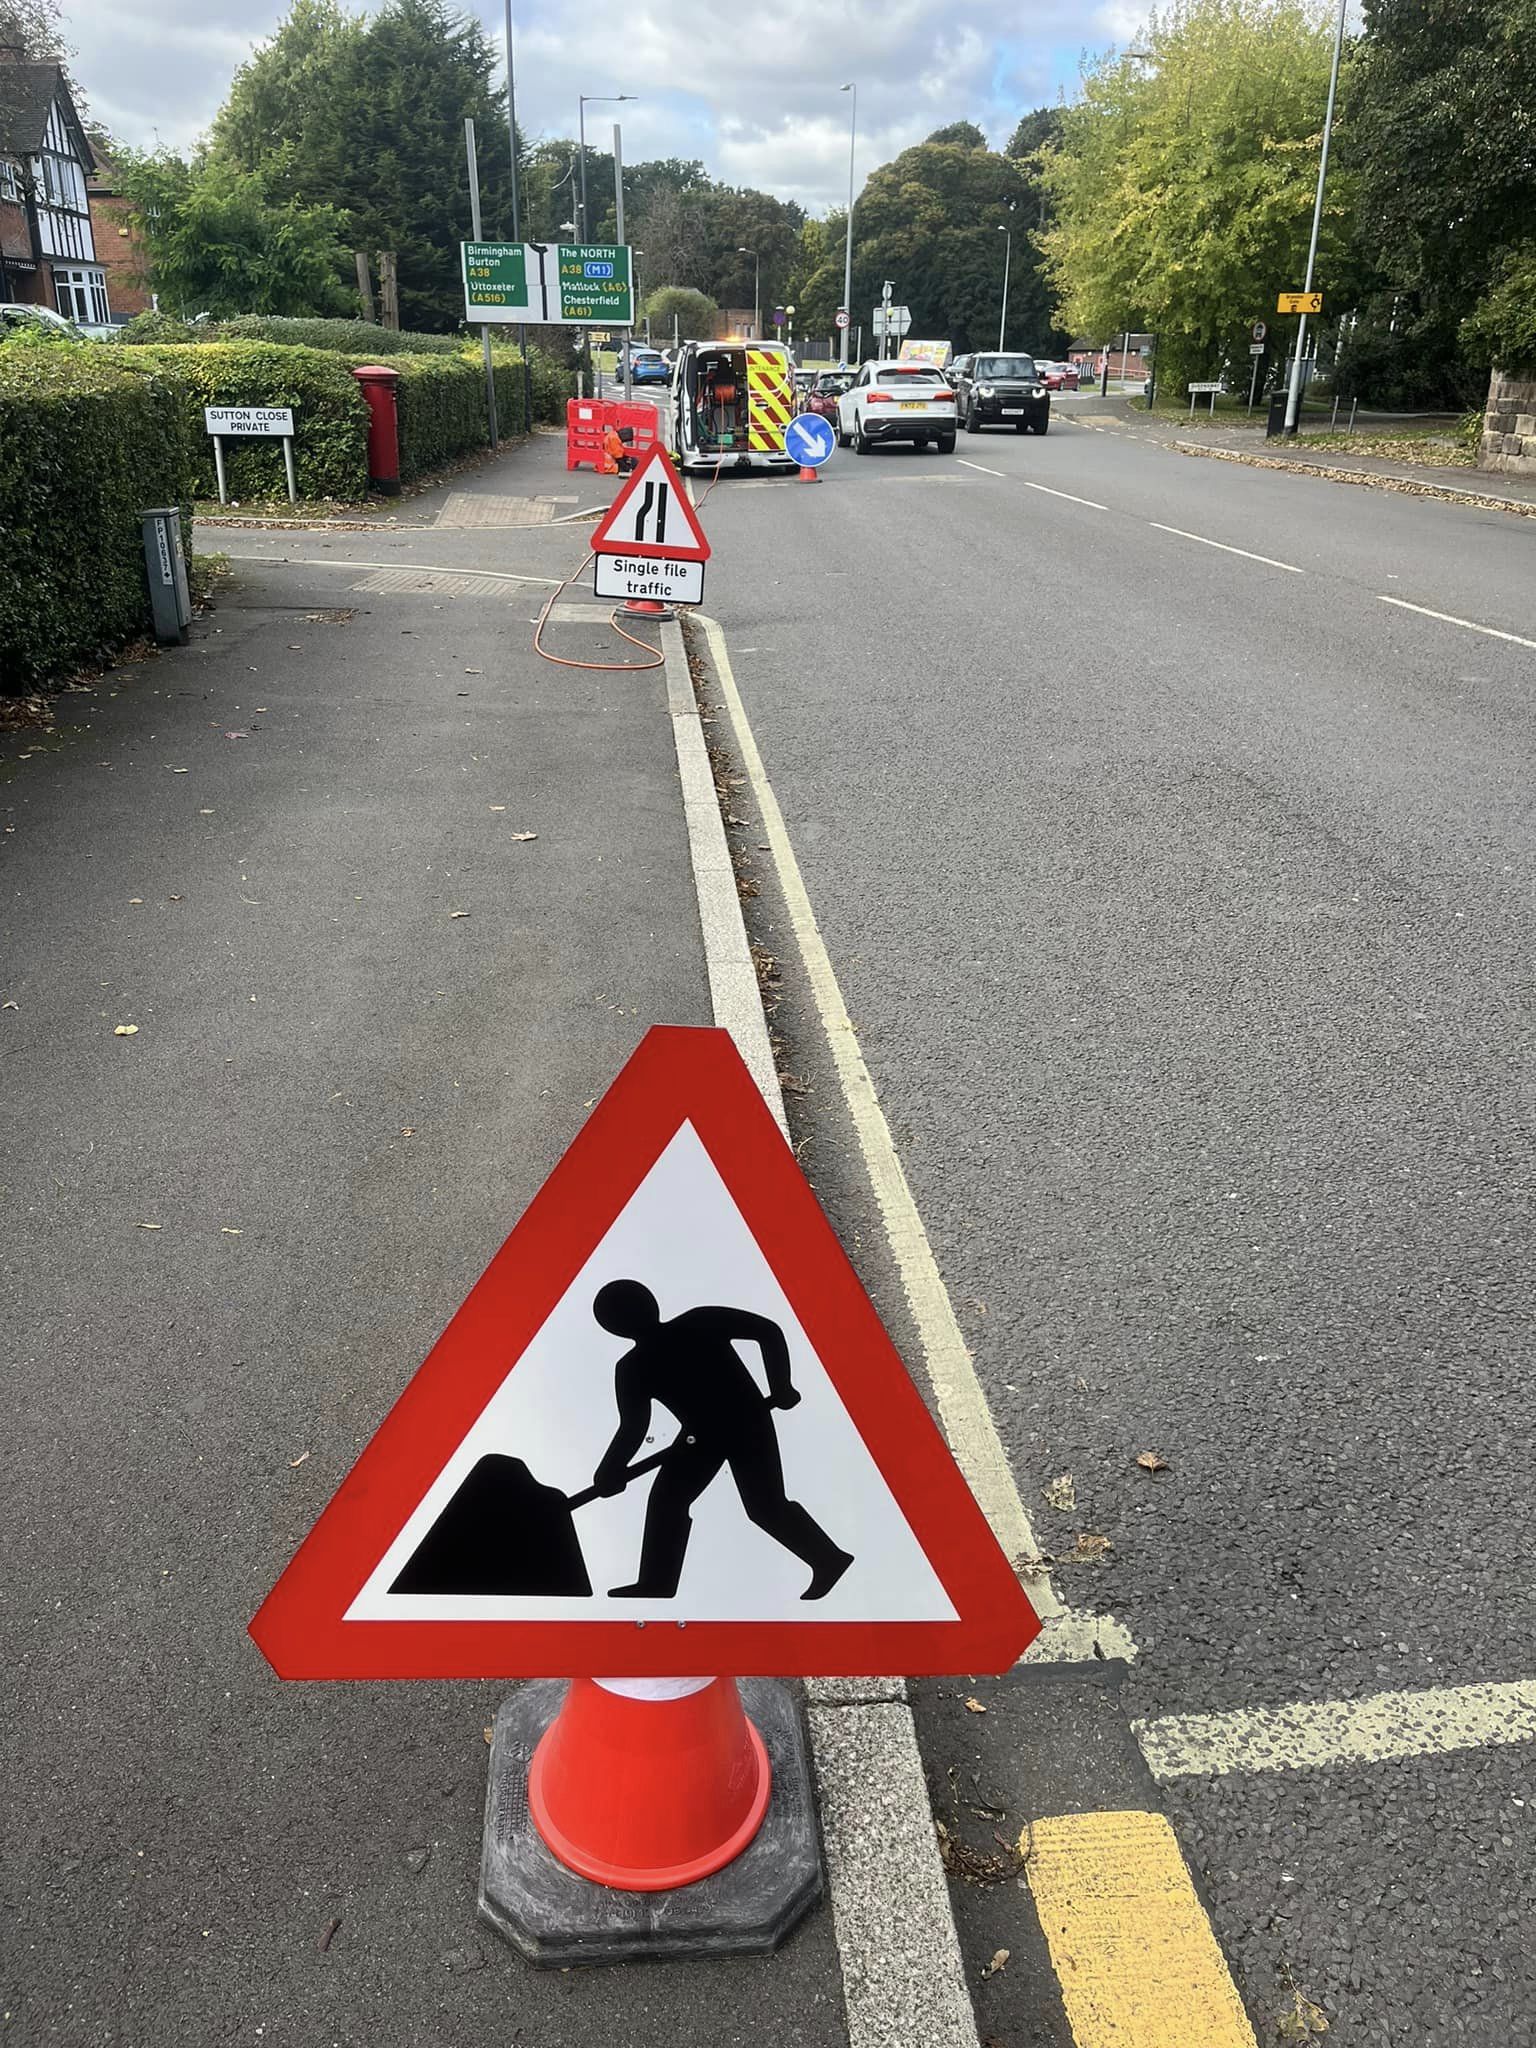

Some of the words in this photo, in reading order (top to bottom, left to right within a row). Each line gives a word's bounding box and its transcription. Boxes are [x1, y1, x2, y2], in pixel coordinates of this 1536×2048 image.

[467, 245, 522, 257] Birmingham
[560, 248, 578, 258] The
[580, 248, 616, 259] NORTH
[468, 256, 500, 266] Burton
[469, 267, 490, 277] A38
[561, 264, 582, 274] A38
[586, 264, 611, 275] (M1)
[470, 281, 516, 291] Uttoxeter
[562, 281, 600, 291] Matlock
[602, 281, 628, 292] (A6)
[472, 292, 506, 303] (A516)
[563, 295, 620, 305] Chesterfield
[564, 305, 592, 317] (A61)
[838, 316, 849, 324] 40
[210, 411, 250, 420] SUTTON
[255, 411, 288, 421] CLOSE
[230, 422, 270, 432] PRIVATE
[613, 559, 659, 576] Single
[664, 563, 687, 578] file
[627, 580, 672, 595] traffic
